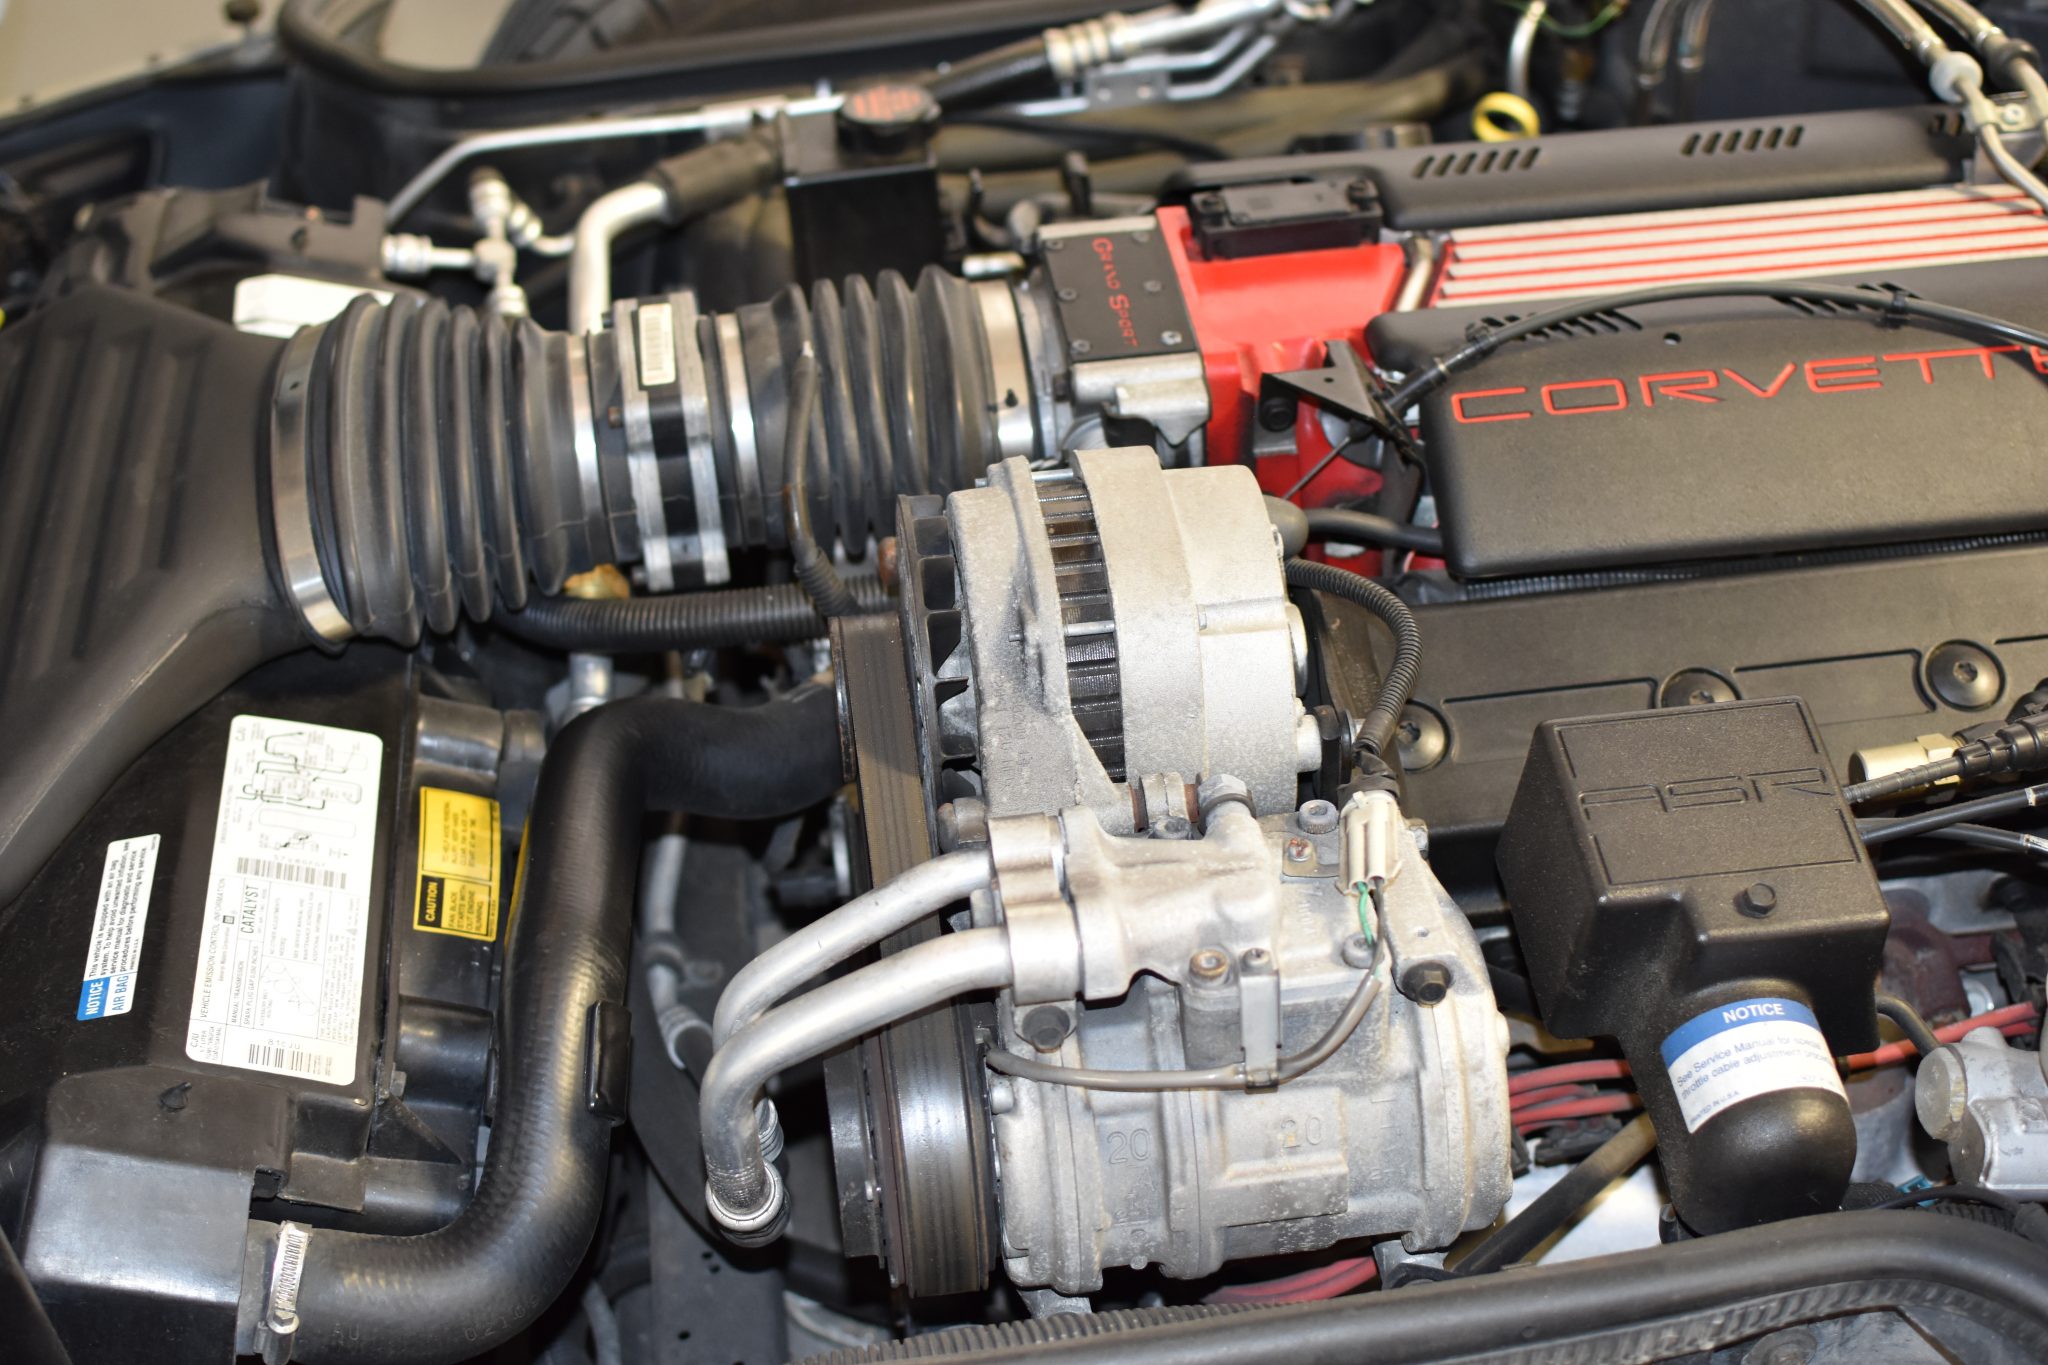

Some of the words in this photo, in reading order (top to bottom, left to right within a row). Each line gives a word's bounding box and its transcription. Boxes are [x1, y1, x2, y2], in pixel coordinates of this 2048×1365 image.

[1450, 345, 2048, 424] CORVETT
[1578, 767, 1836, 820] ASR
[109, 859, 119, 871] bag
[128, 850, 137, 871] service
[107, 880, 113, 888] an
[135, 869, 144, 880] any
[112, 878, 123, 908] unwanted
[118, 884, 131, 916] diagnostic
[129, 881, 143, 914] performing
[213, 877, 225, 921] INFORMATION
[425, 882, 437, 921] CAUTION
[98, 903, 109, 932] equipped
[108, 908, 118, 926] avoid
[116, 917, 125, 926] for
[239, 884, 259, 934] CATALYST
[105, 926, 115, 941] help
[113, 926, 123, 950] manual
[124, 915, 135, 935] before
[93, 939, 103, 962] vehicle
[102, 941, 112, 950] To
[208, 923, 220, 954] CONTROL
[99, 950, 109, 976] system.
[109, 950, 119, 974] service
[119, 936, 131, 973] procedures
[88, 963, 98, 978] This
[203, 955, 215, 988] EMISSION
[233, 960, 244, 999] TRANSMISSION
[114, 975, 129, 994] BAG
[84, 980, 104, 1016] NOTICE
[111, 995, 126, 1011] AIR
[199, 989, 211, 1018] VEHICLE
[231, 1001, 239, 1023] MANUAL
[1722, 1003, 1785, 1024] NOTICE
[189, 1032, 200, 1048] CJU
[1677, 1071, 1694, 1088] See
[1694, 1048, 1731, 1073] Service
[1734, 1038, 1775, 1054] Manual
[1681, 1074, 1709, 1099] throttle
[1711, 1060, 1740, 1077] cable
[1743, 1049, 1800, 1067] adjustment
[1106, 1127, 1151, 1165] 20
